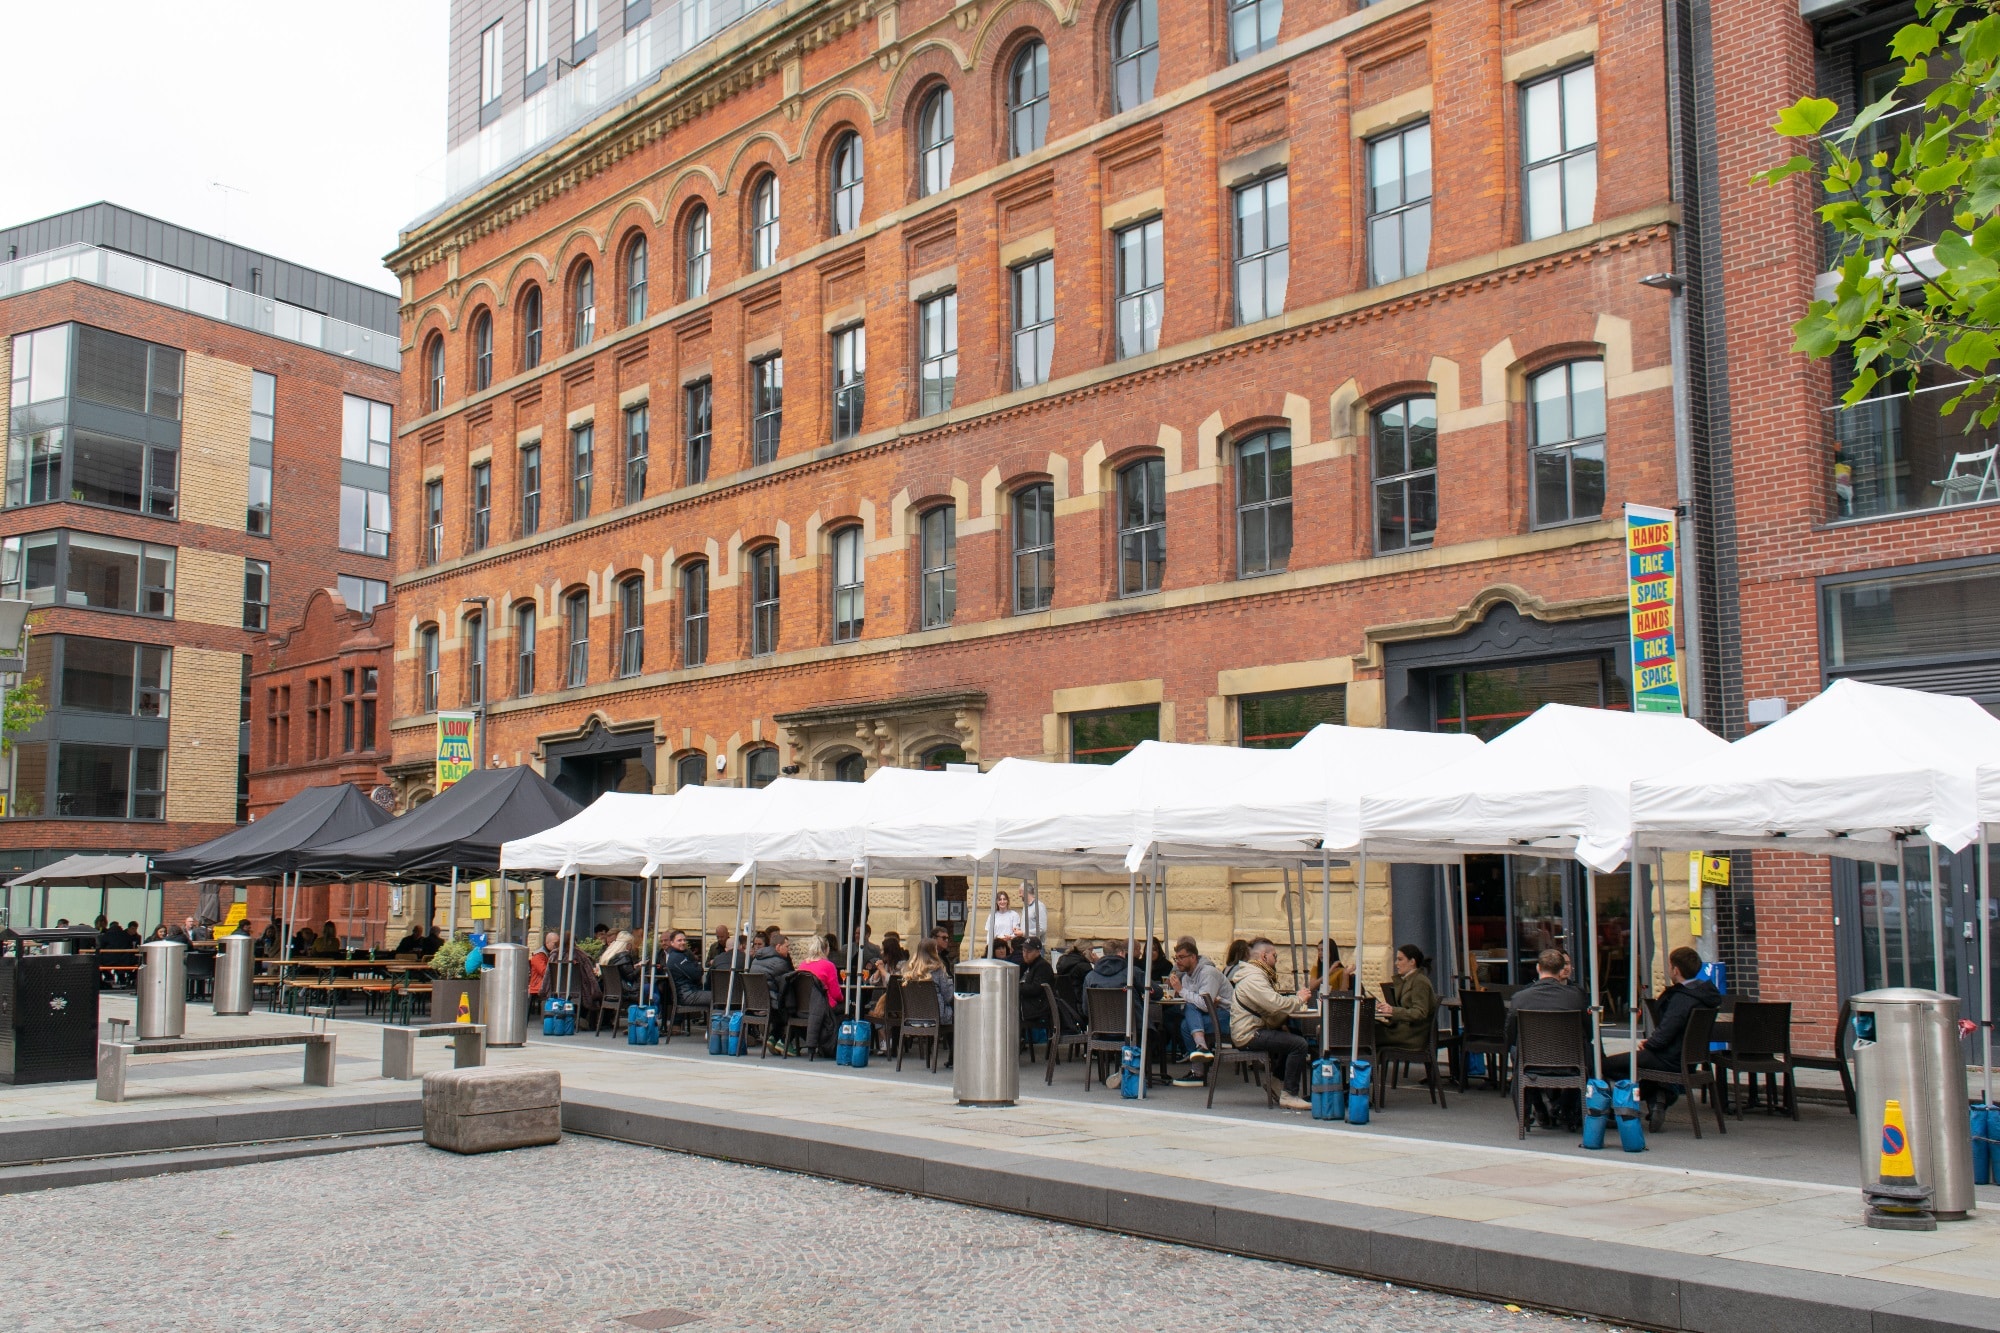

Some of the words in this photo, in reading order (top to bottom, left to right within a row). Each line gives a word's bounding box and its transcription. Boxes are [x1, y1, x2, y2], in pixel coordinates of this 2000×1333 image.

[1633, 524, 1669, 547] HANDS
[1640, 553, 1664, 574] FACE
[1637, 581, 1667, 603] SPACE
[1637, 609, 1669, 632] HANDS
[1643, 637, 1668, 660] FACE
[1641, 665, 1672, 688] SPACE
[442, 720, 470, 736] LOOK
[441, 742, 470, 758] AFTER
[441, 764, 470, 780] EACH
